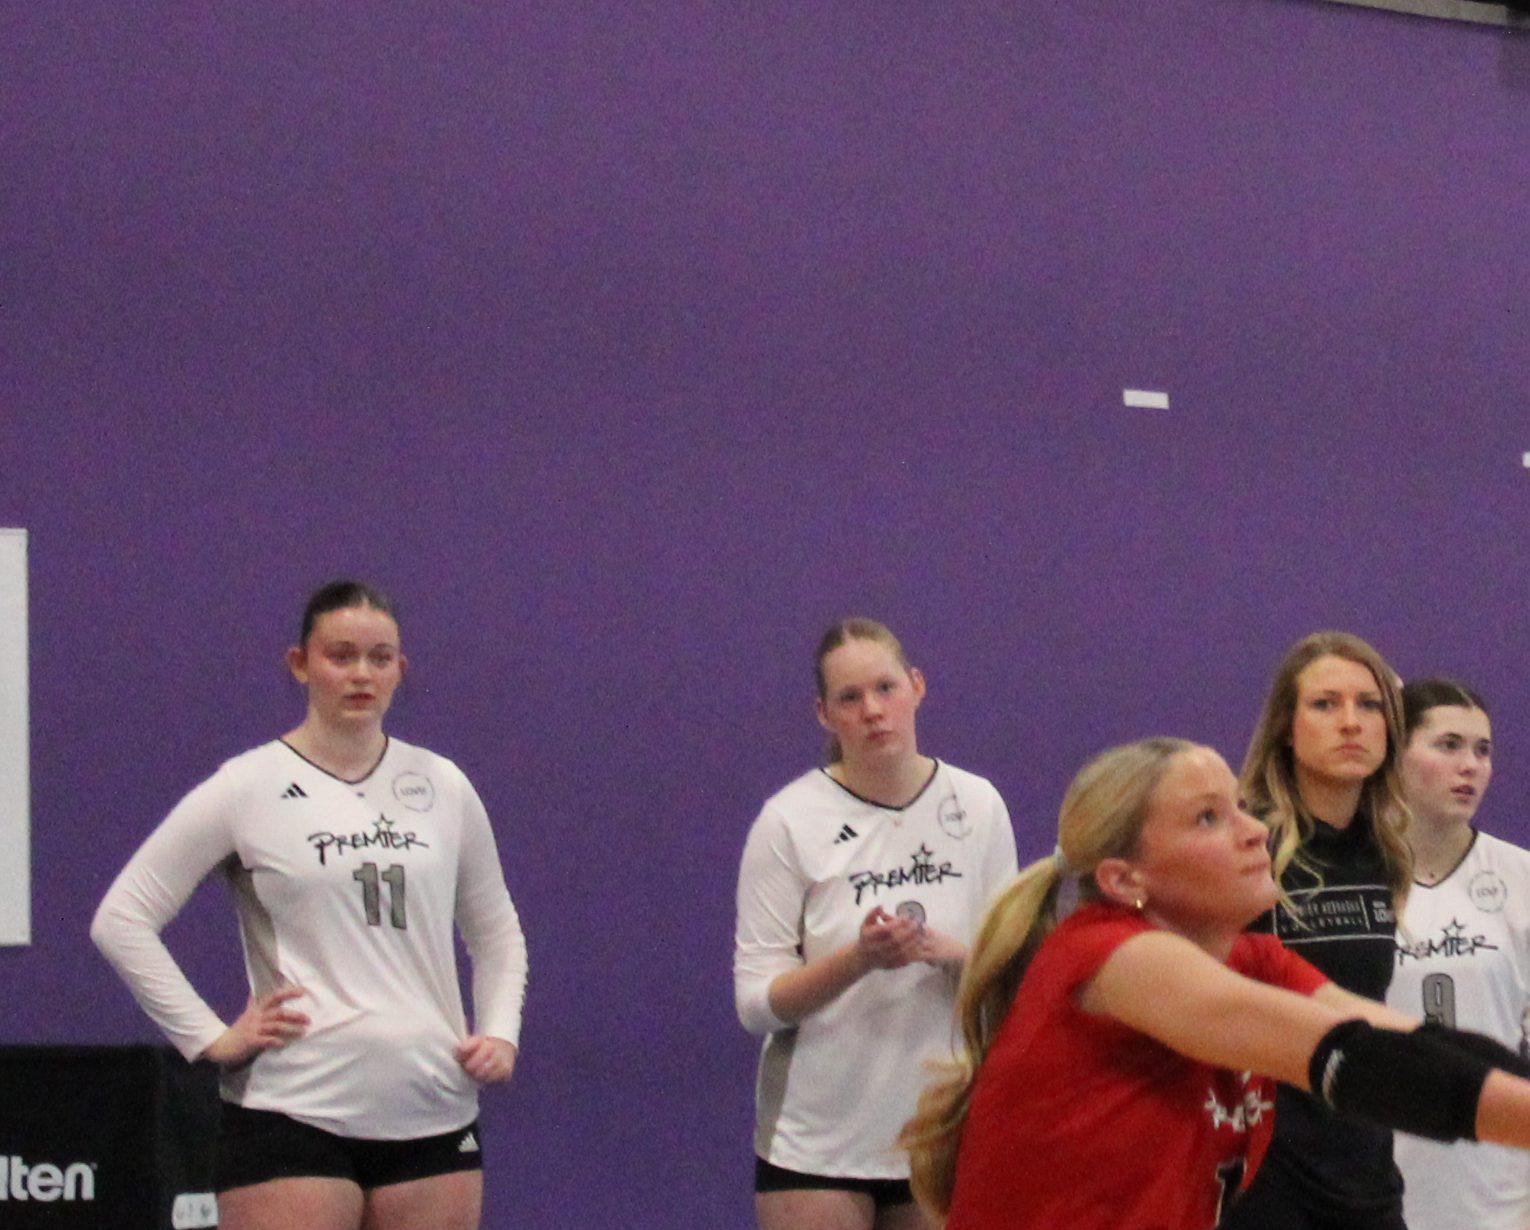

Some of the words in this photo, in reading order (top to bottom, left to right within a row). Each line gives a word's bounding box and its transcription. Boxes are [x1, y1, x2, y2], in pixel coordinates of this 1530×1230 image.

[308, 813, 429, 865] PREMIER
[353, 862, 407, 930] 11
[849, 843, 962, 905] PREMIER
[1392, 917, 1498, 966] REMIER
[1422, 973, 1456, 1030] 9
